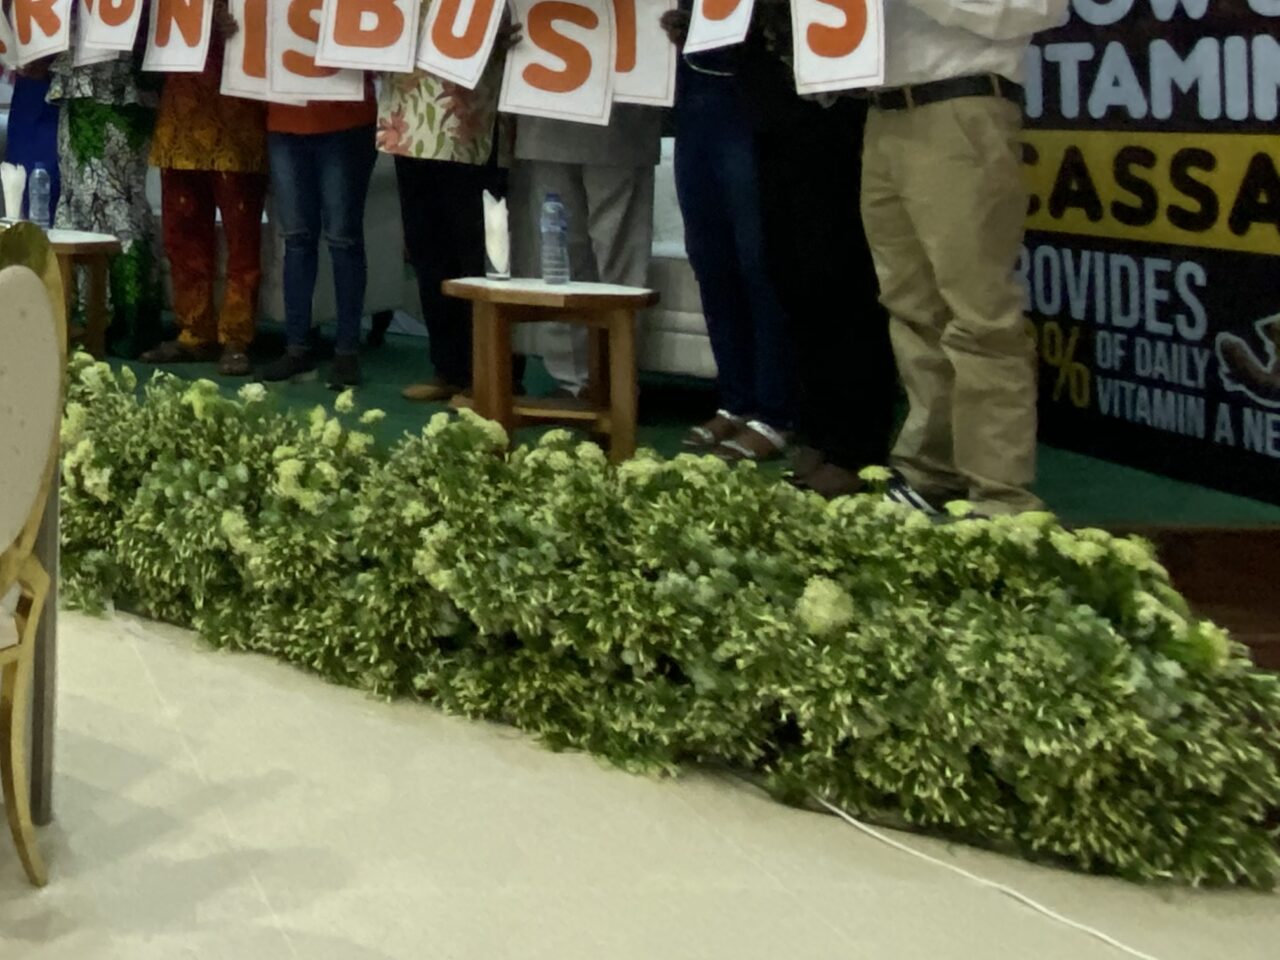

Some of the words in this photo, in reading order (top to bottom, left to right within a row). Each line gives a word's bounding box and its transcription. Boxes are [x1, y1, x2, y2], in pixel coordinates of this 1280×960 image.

[1022, 142, 1280, 236] ASSA
[1014, 243, 1209, 341] ROVIDES
[1096, 330, 1128, 371] OF
[1135, 336, 1211, 389] DAILY
[1096, 374, 1206, 439] VITAMIN
[1214, 402, 1235, 446] A
